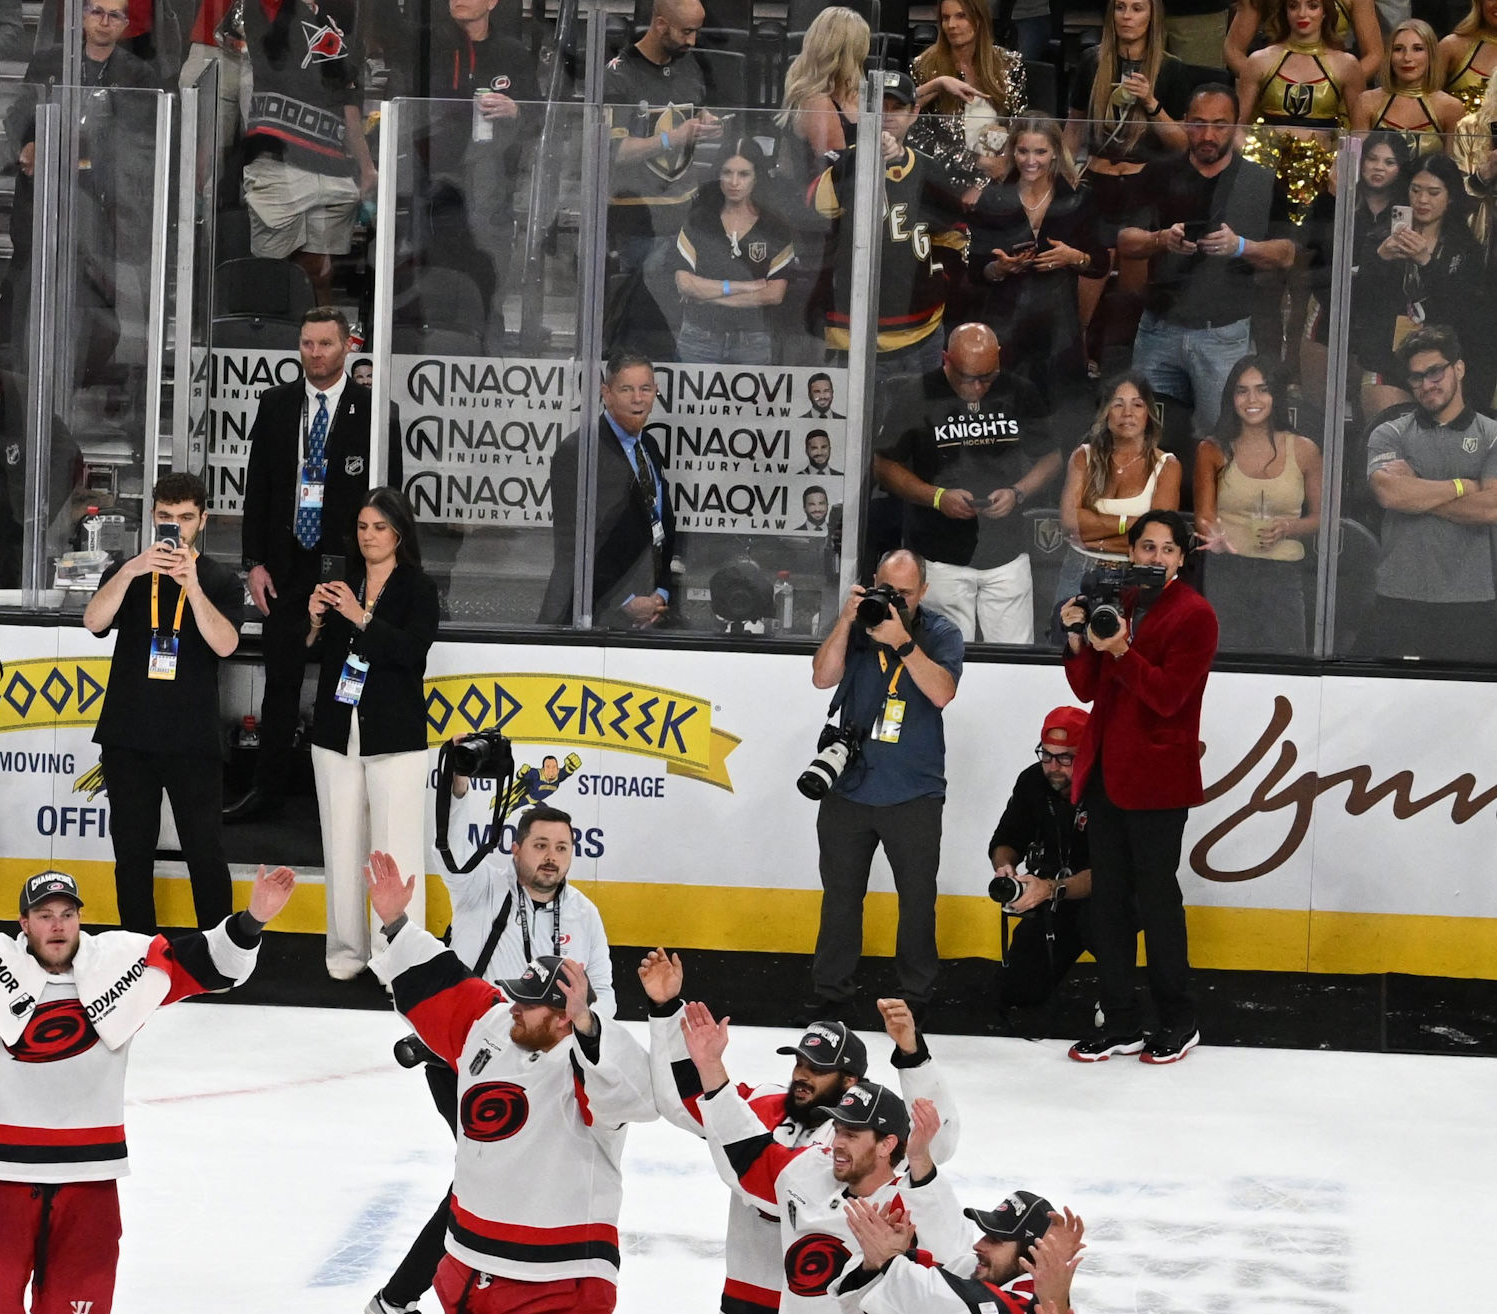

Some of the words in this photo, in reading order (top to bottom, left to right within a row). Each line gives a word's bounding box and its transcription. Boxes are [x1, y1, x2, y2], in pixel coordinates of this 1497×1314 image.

[450, 363, 564, 398] NAQVI
[678, 370, 793, 405] NAQVI
[223, 389, 263, 400] INJU
[450, 397, 515, 408] INJURY
[527, 399, 563, 410] LAW
[678, 404, 743, 415] INJURY
[755, 407, 791, 417] LAW
[947, 412, 1004, 423] GOLDEN
[448, 418, 563, 454] NAQVI
[934, 419, 1019, 441] KNIGHTS
[222, 444, 247, 455] INJ
[676, 426, 791, 461] NAQVI
[962, 438, 997, 446] HOCKEY
[448, 452, 513, 464] INJURY
[525, 456, 552, 466] LA
[675, 459, 741, 471] INJURY
[753, 462, 789, 474] LAW
[447, 475, 552, 509] NAQV
[674, 482, 788, 517] NAQVI
[446, 508, 511, 519] INJURY
[751, 518, 786, 530] LAW
[426, 682, 522, 733] OOD
[545, 683, 699, 754] GREEK
[577, 775, 665, 799] STORAGE
[84, 956, 148, 1021] ODYARMOR
